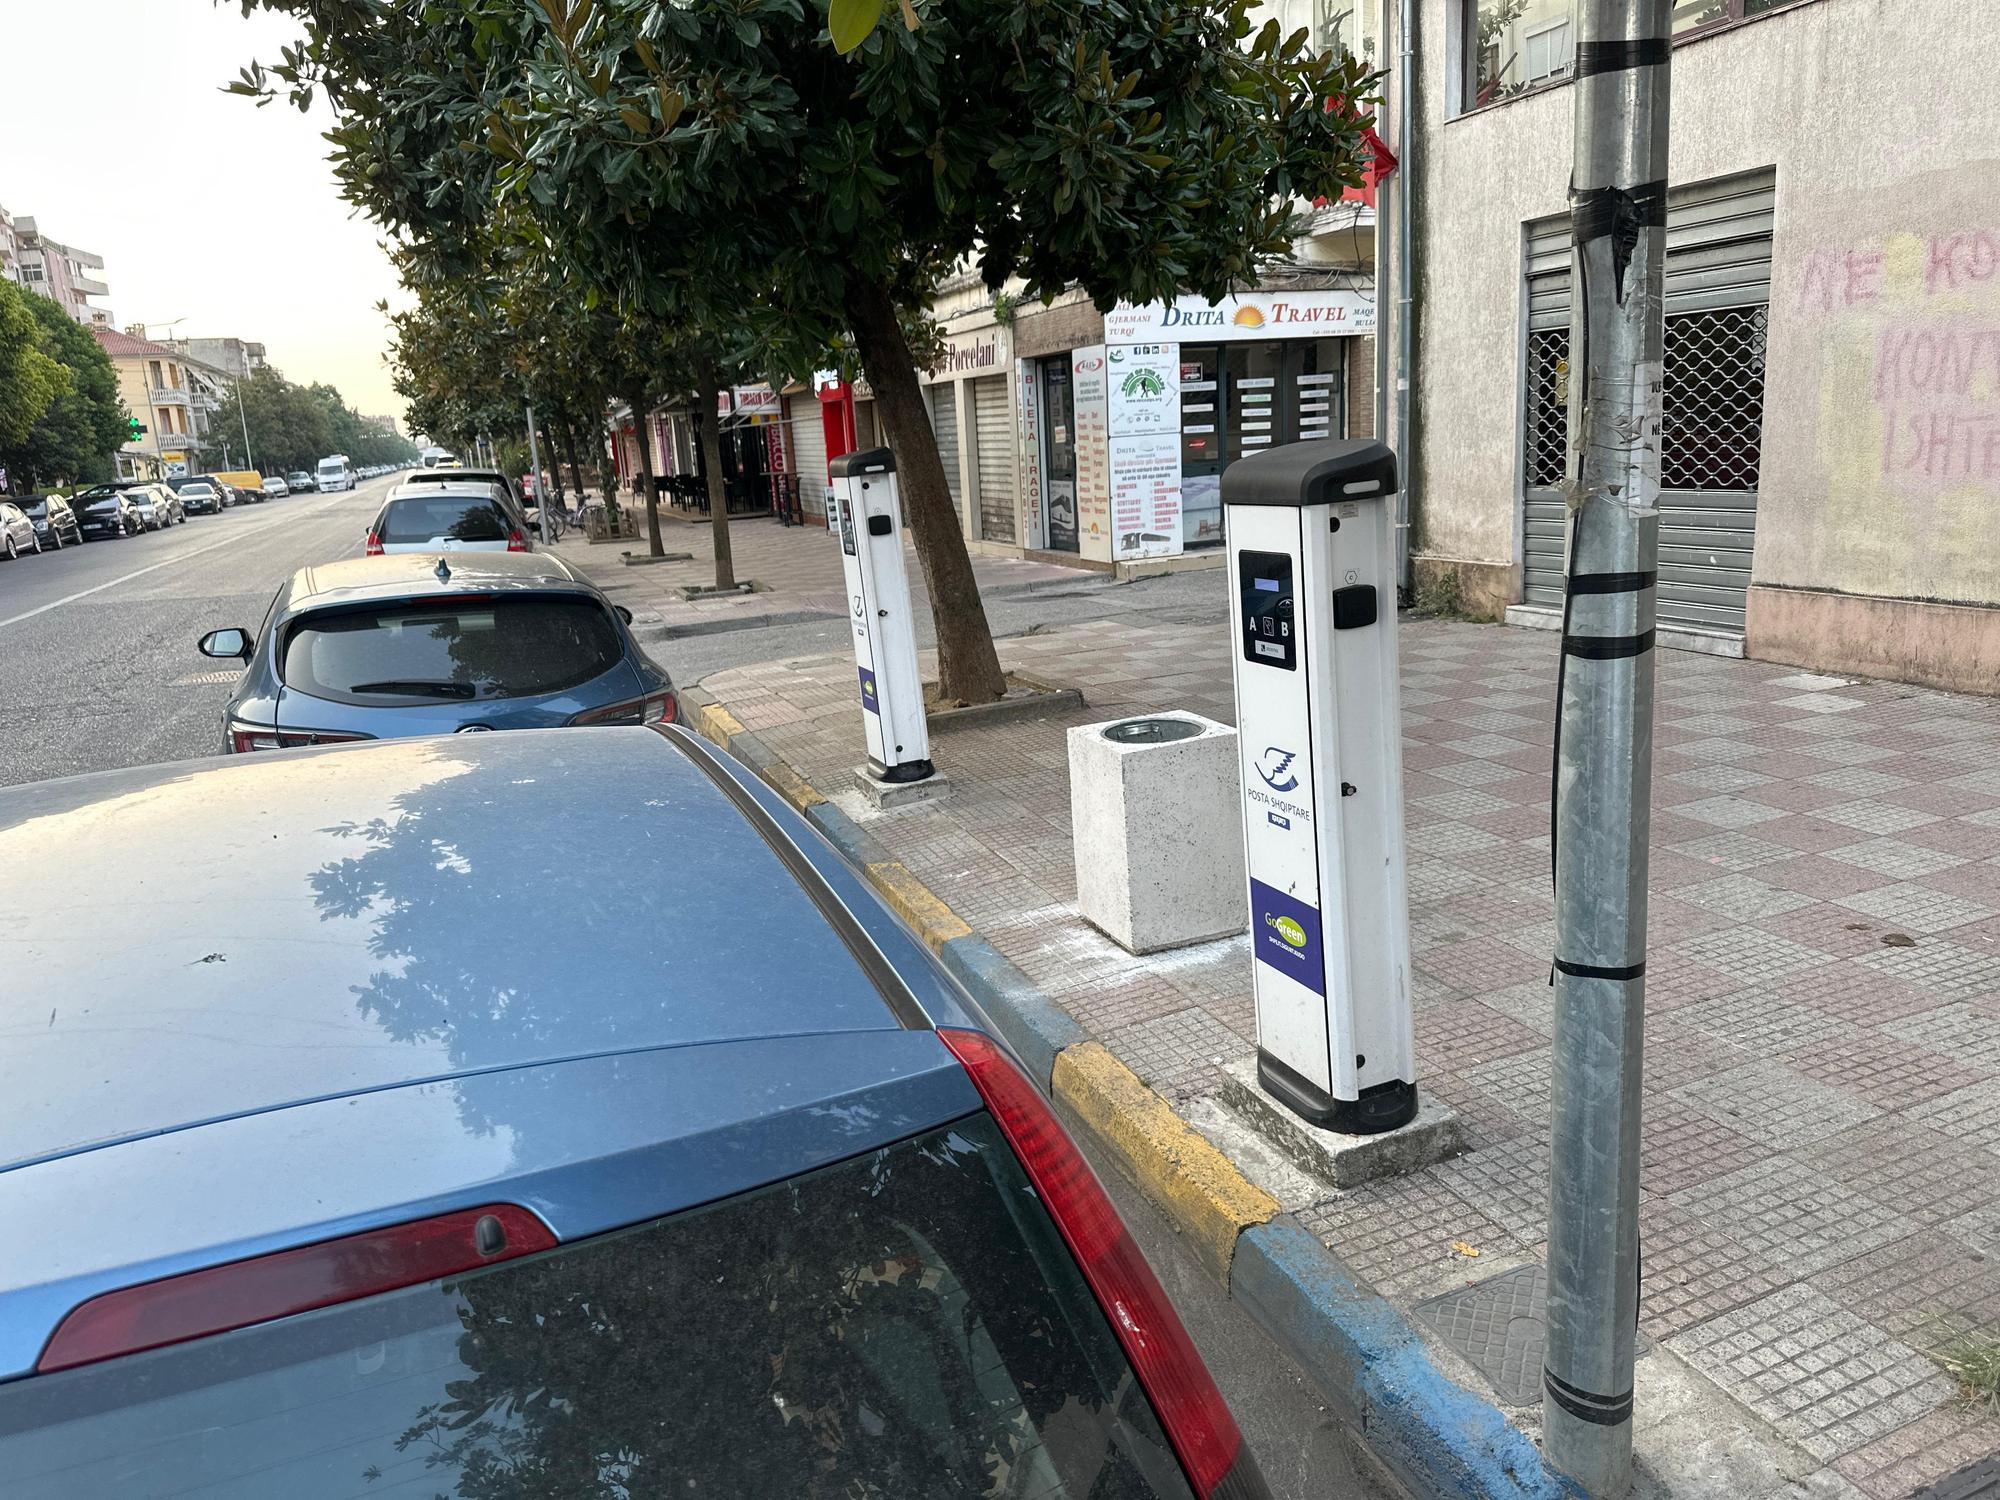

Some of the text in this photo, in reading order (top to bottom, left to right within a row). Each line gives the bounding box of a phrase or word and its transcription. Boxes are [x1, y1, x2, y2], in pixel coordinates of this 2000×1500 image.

[1108, 315, 1151, 324] GJERMANI
[1160, 303, 1347, 327] DRITA TRAVEL
[1108, 328, 1135, 337] TURQI
[948, 332, 996, 373] Porcelani
[1025, 374, 1040, 529] BILETA TRAGETI
[1250, 616, 1289, 637] A B
[1248, 788, 1270, 805] POSTA
[1271, 797, 1311, 822] SHQIPTARE
